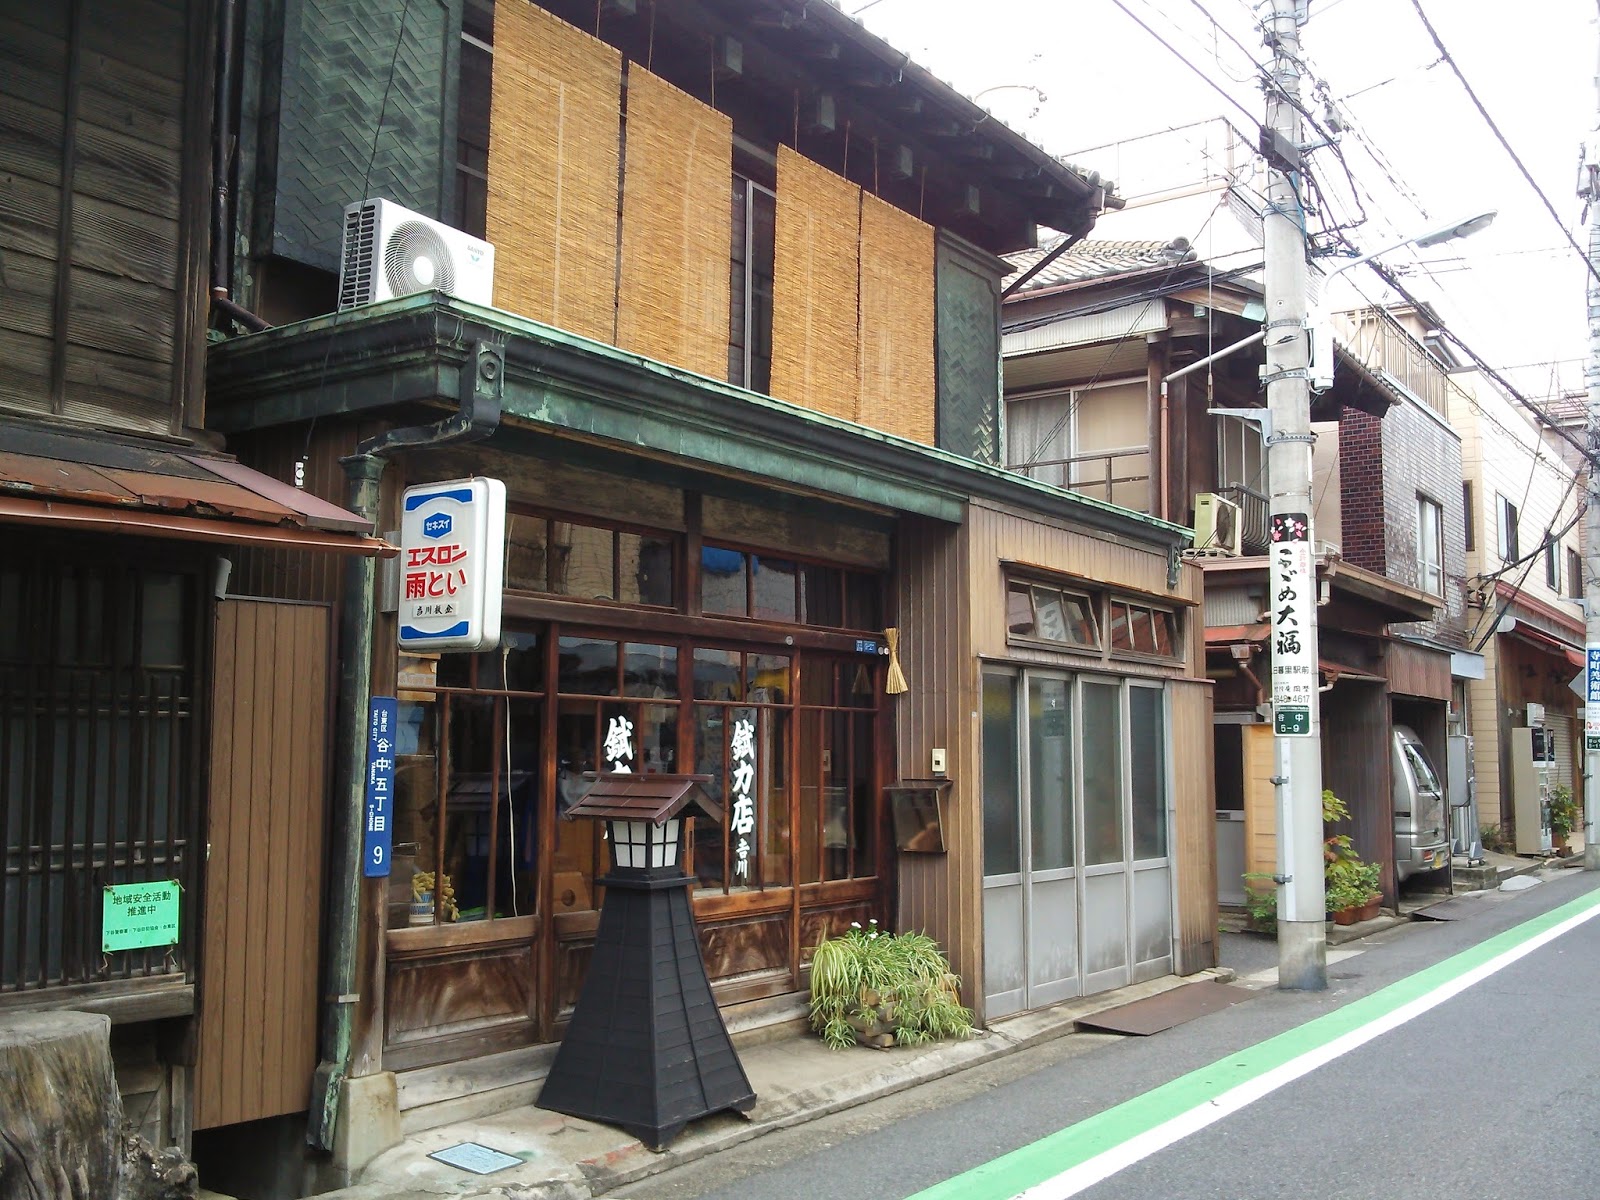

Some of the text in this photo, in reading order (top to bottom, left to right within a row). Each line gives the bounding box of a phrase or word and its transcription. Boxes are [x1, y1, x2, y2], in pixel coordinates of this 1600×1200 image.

[426, 519, 450, 531] セキスイ
[407, 544, 467, 567] エスロン
[406, 569, 466, 599] 雨とい
[1278, 713, 1304, 722] 谷中
[1281, 724, 1300, 733] 5-9
[373, 709, 390, 865] 台東区 谷中五丁目 9
[112, 890, 172, 905] 地域安全活動
[127, 905, 157, 917] 推進中
